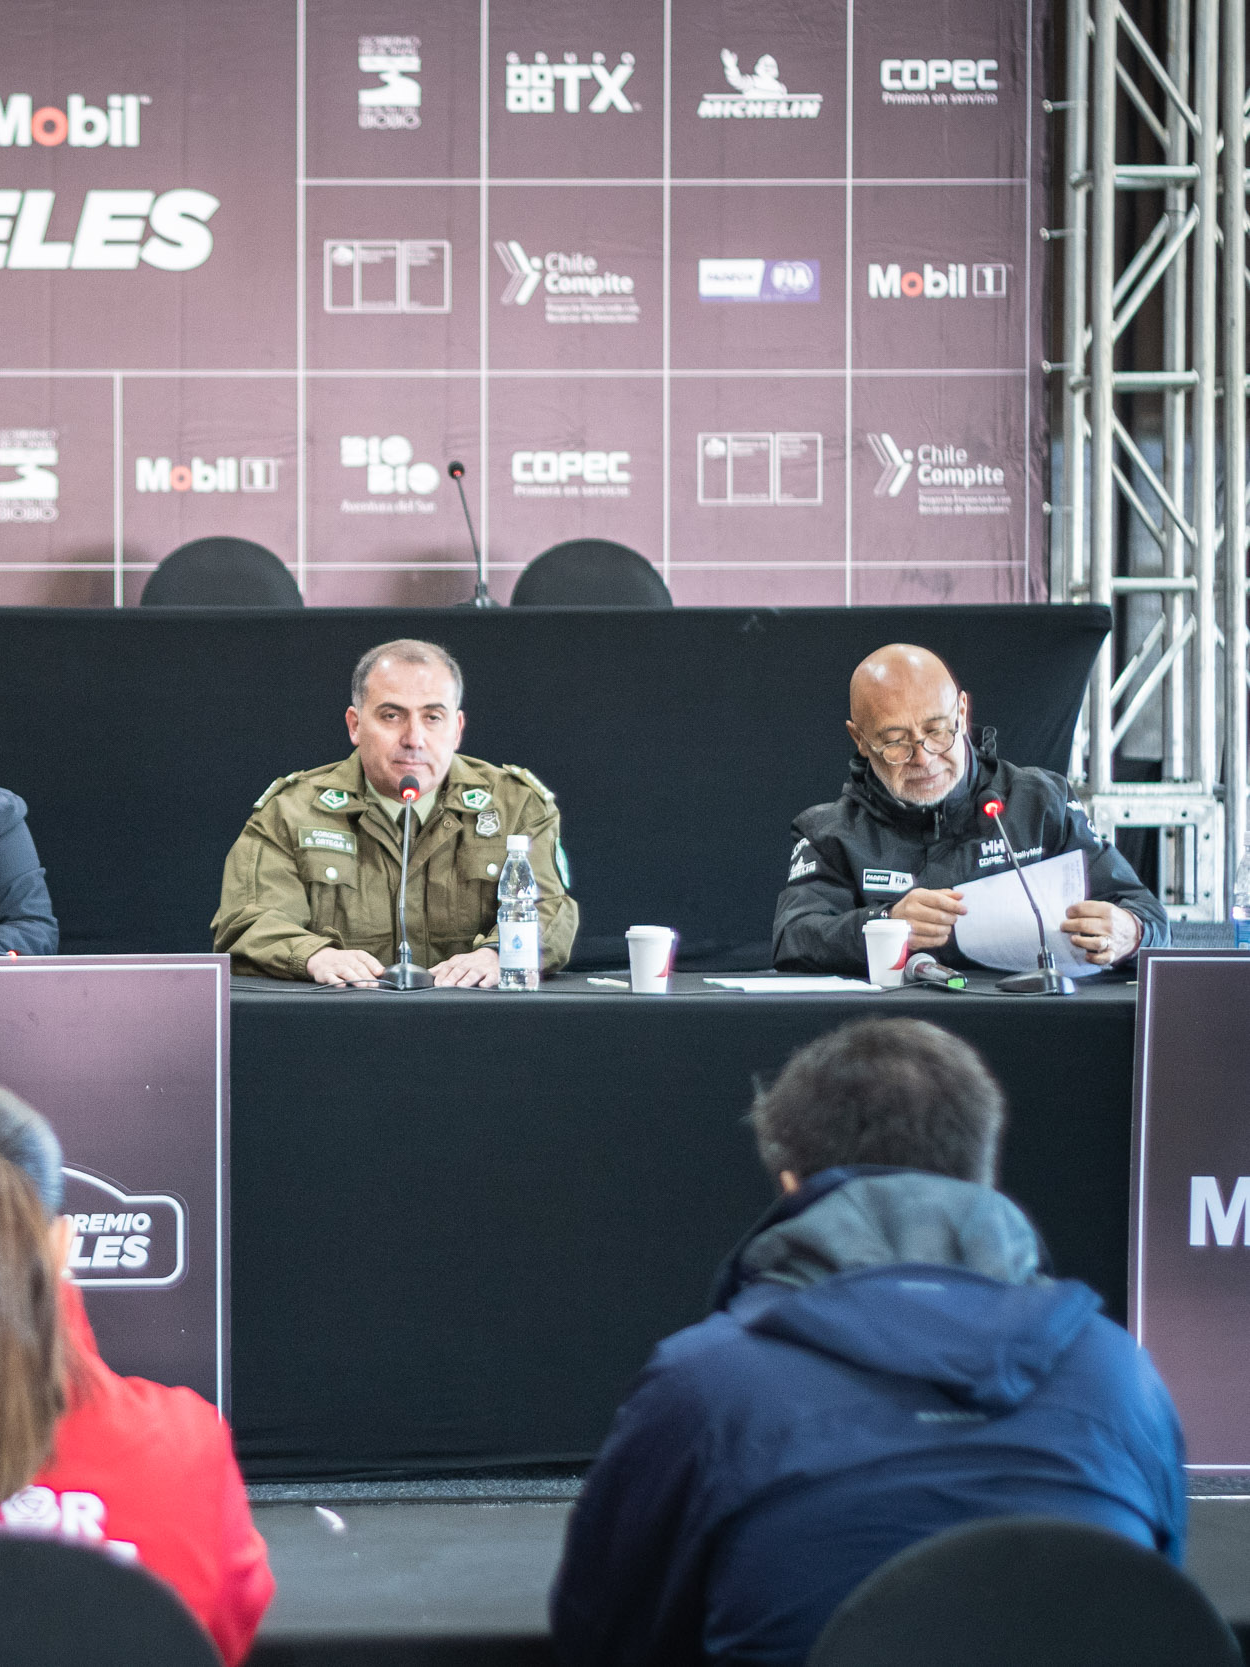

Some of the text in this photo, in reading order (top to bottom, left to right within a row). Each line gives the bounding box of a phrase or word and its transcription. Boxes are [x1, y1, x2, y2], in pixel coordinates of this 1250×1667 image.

[880, 59, 998, 91] COPEC
[698, 101, 821, 118] MICHELIN
[545, 251, 597, 274] Chile
[544, 271, 634, 298] Compite
[868, 263, 967, 299] Mobil
[340, 435, 413, 468] BIO
[512, 451, 631, 484] COPEC
[917, 444, 968, 466] Chile
[136, 456, 238, 493] Mobil
[367, 462, 440, 495] BIO
[917, 463, 1005, 489] Compite
[978, 854, 1006, 869] COPEC
[67, 1234, 151, 1268] LES
